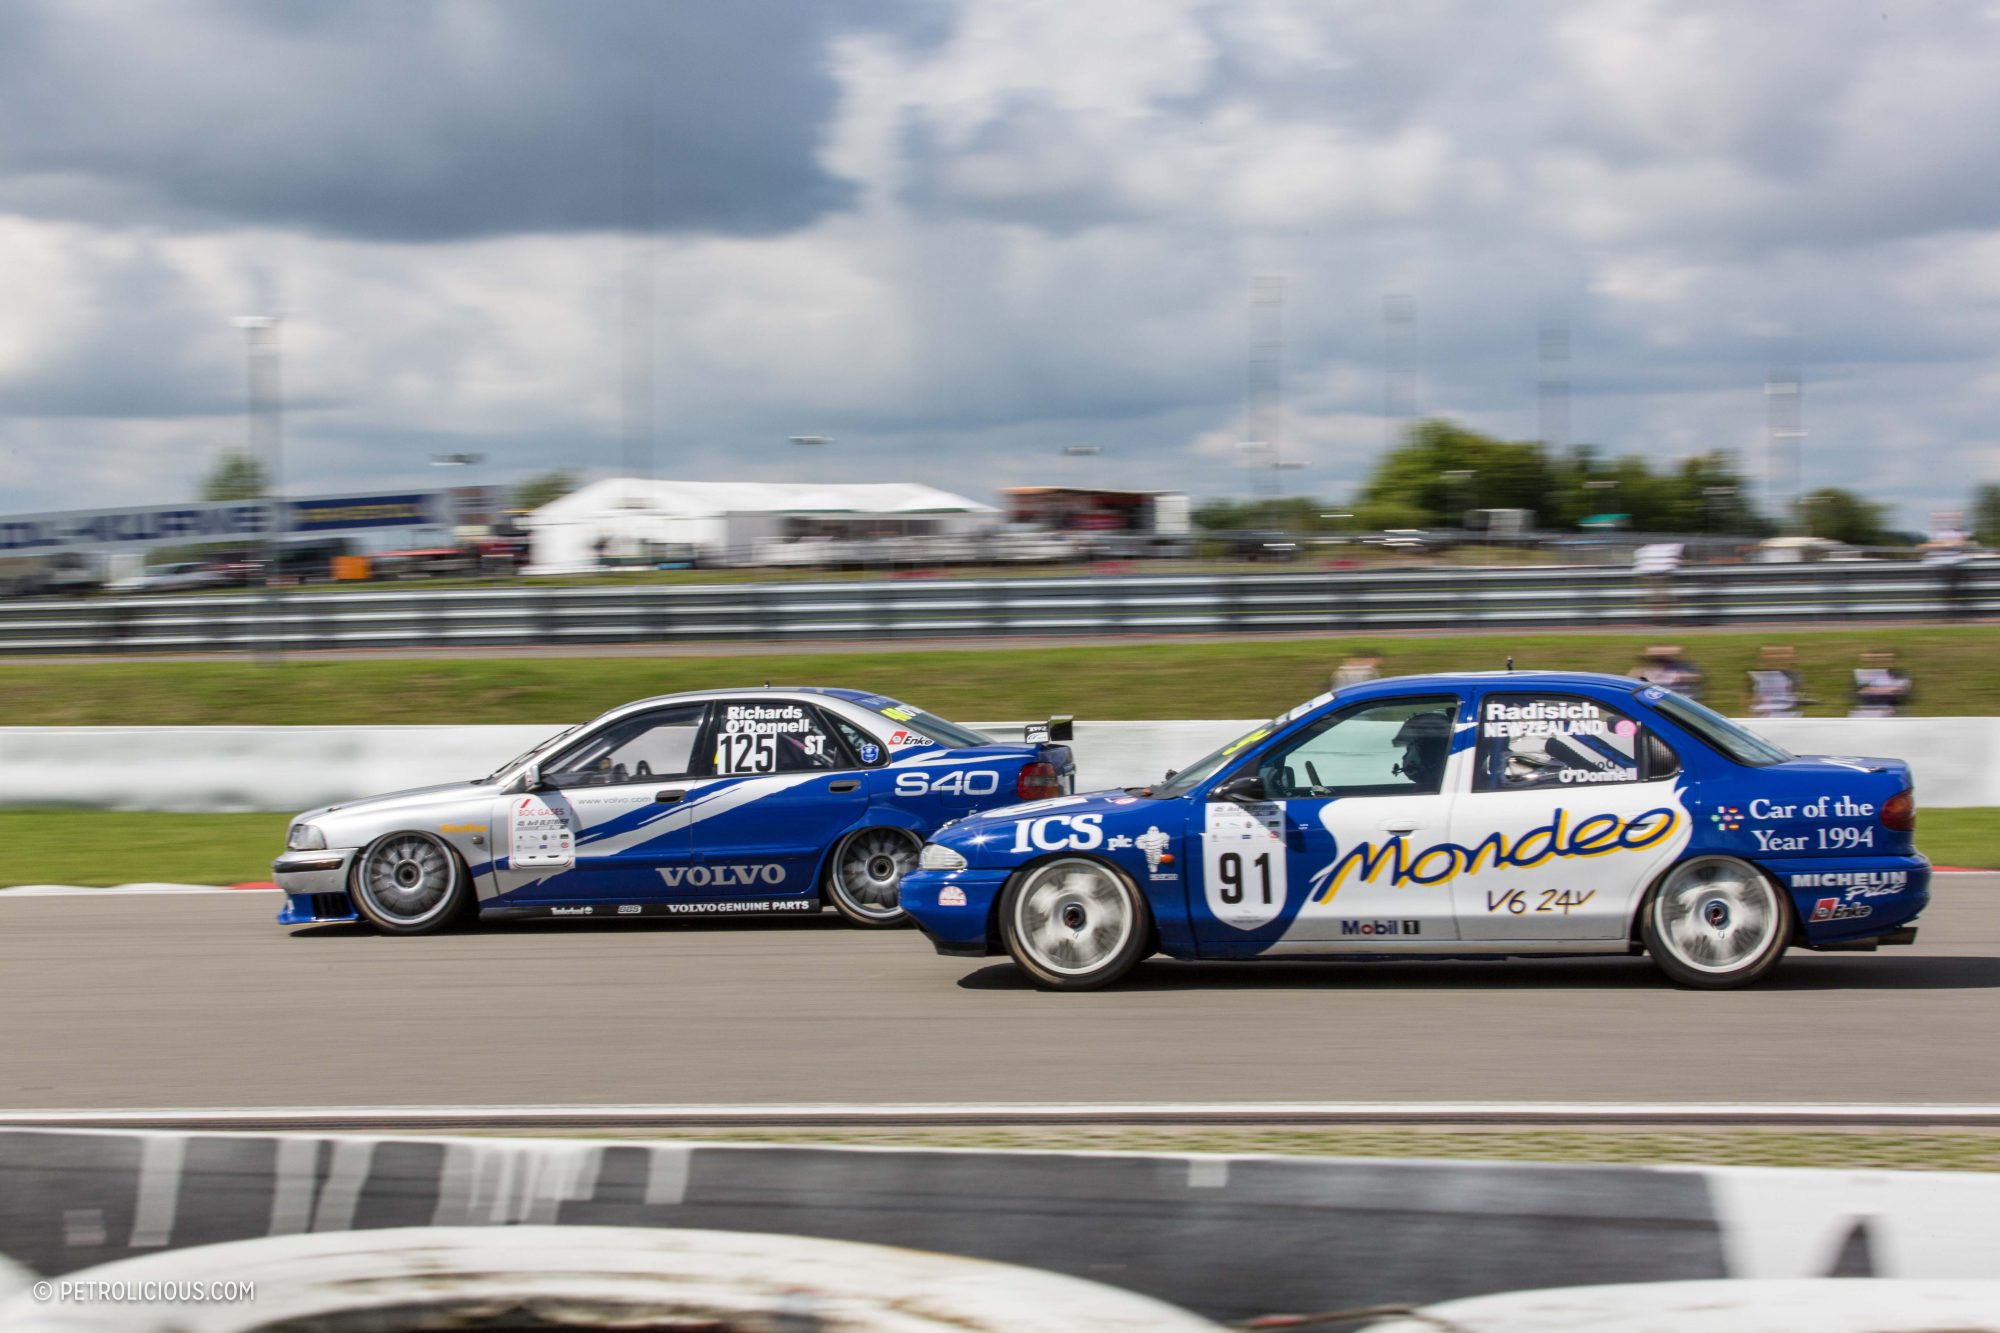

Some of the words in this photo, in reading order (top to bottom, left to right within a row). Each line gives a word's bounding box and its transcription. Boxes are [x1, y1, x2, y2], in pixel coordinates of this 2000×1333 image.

[727, 706, 803, 720] Richards
[1486, 702, 1600, 720] Radisich
[725, 719, 810, 734] O'Donnell
[1526, 720, 1605, 736] ZEALAND
[804, 735, 826, 755] ST
[903, 735, 934, 746] Enke
[720, 734, 775, 773] 125
[894, 770, 999, 797] S40
[1749, 798, 1798, 820] Car
[1802, 796, 1831, 818] of
[1833, 795, 1875, 817] the
[1010, 814, 1104, 854] ICS
[1106, 834, 1134, 851] plc
[1750, 829, 1810, 852] Year
[1816, 825, 1874, 850] 1994
[1312, 807, 1681, 906] Mondeo
[655, 863, 787, 887] VOLVO
[1219, 852, 1273, 905] 91
[1791, 871, 1907, 887] MICHELIN
[1487, 890, 1527, 915] V6
[1844, 884, 1906, 901] Pilot
[667, 904, 717, 912] VOLVO
[717, 902, 770, 912] GENUINE
[772, 901, 810, 911] PARTS
[1340, 920, 1399, 936] Mobil
